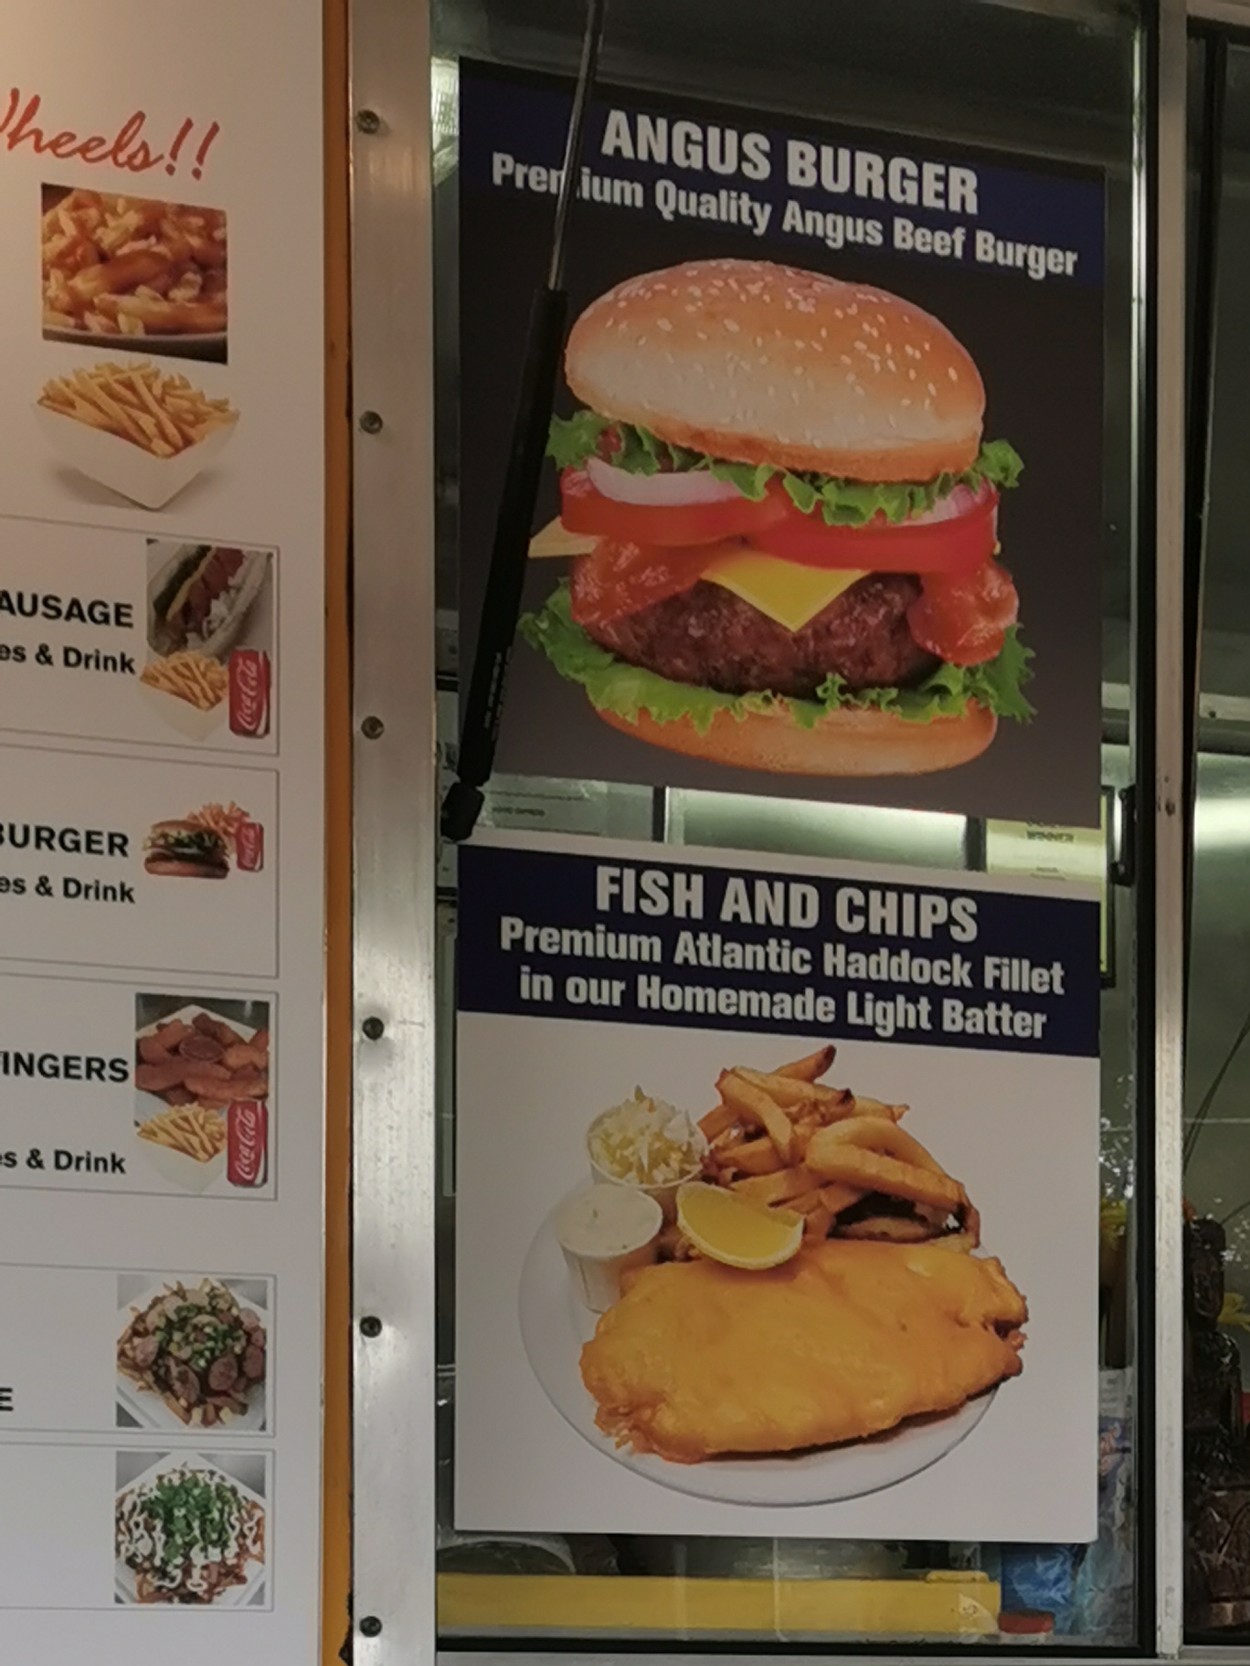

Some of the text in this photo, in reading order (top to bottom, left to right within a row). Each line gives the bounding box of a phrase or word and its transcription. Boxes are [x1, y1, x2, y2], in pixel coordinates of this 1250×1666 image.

[601, 109, 978, 215] ANGUS BURGER
[654, 179, 773, 236] Quality
[782, 200, 883, 249] Angus
[893, 216, 967, 260] Beef
[975, 229, 1078, 281] Burger
[35, 643, 54, 667] &
[63, 646, 136, 675] Drink
[0, 822, 129, 858] URGER
[35, 875, 54, 898] &
[63, 877, 136, 904] Drink
[596, 865, 979, 943] FISH AND CHIPS
[500, 916, 1065, 996] Premium Atlantic Haddock Fillet
[519, 965, 1047, 1039] in our Homemade Light Batter
[1, 1052, 129, 1083] INGERS
[26, 1148, 45, 1171] &
[54, 1150, 127, 1174] Drink
